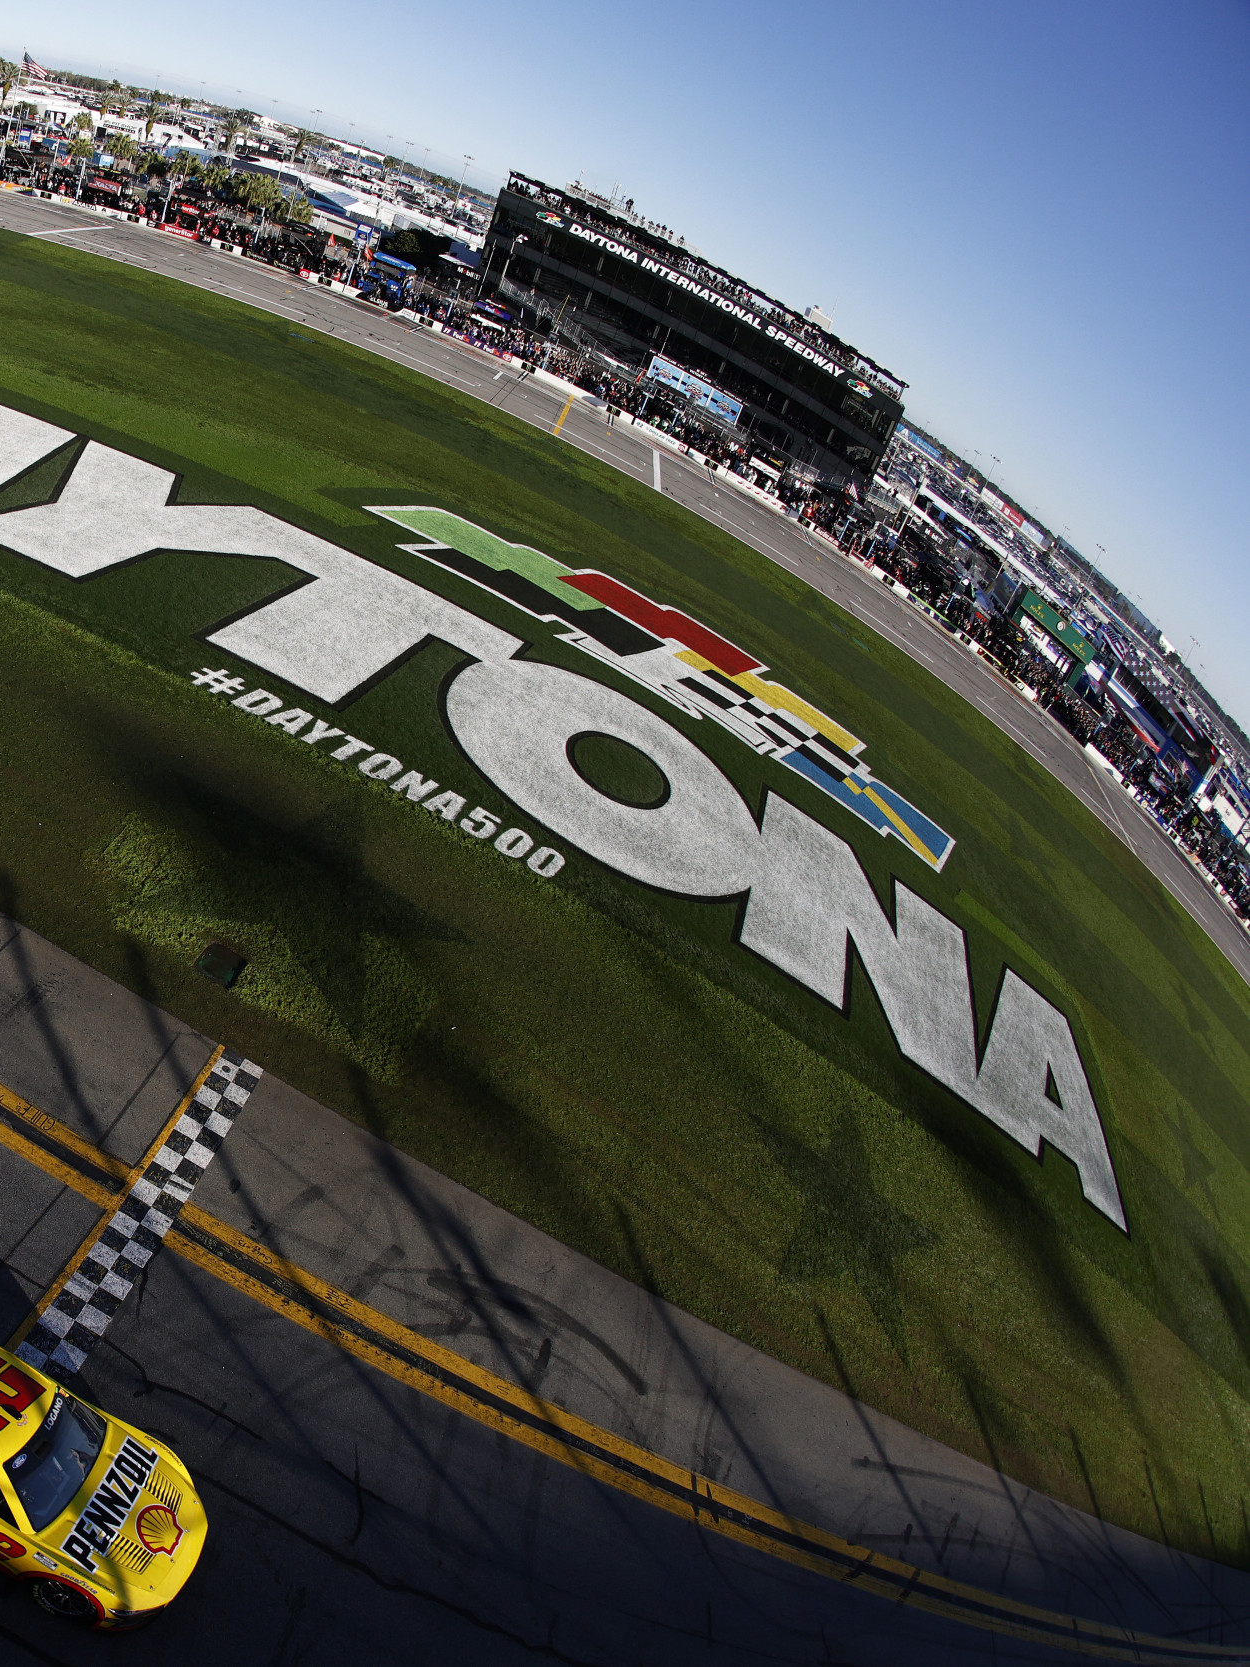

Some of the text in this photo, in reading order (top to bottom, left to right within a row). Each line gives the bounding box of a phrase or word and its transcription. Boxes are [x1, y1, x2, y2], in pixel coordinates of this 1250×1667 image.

[568, 223, 846, 379] DAYTONA INTERNATIONAL SPEEDWAY
[452, 330, 470, 343] FedEx
[483, 344, 501, 357] FedEx
[1029, 603, 1046, 620] ROLEX
[1072, 642, 1087, 657] ROLEX
[190, 667, 566, 878] #DAYTONA500
[44, 1396, 64, 1431] LOGANO
[59, 1434, 161, 1576] PENNZOIL
